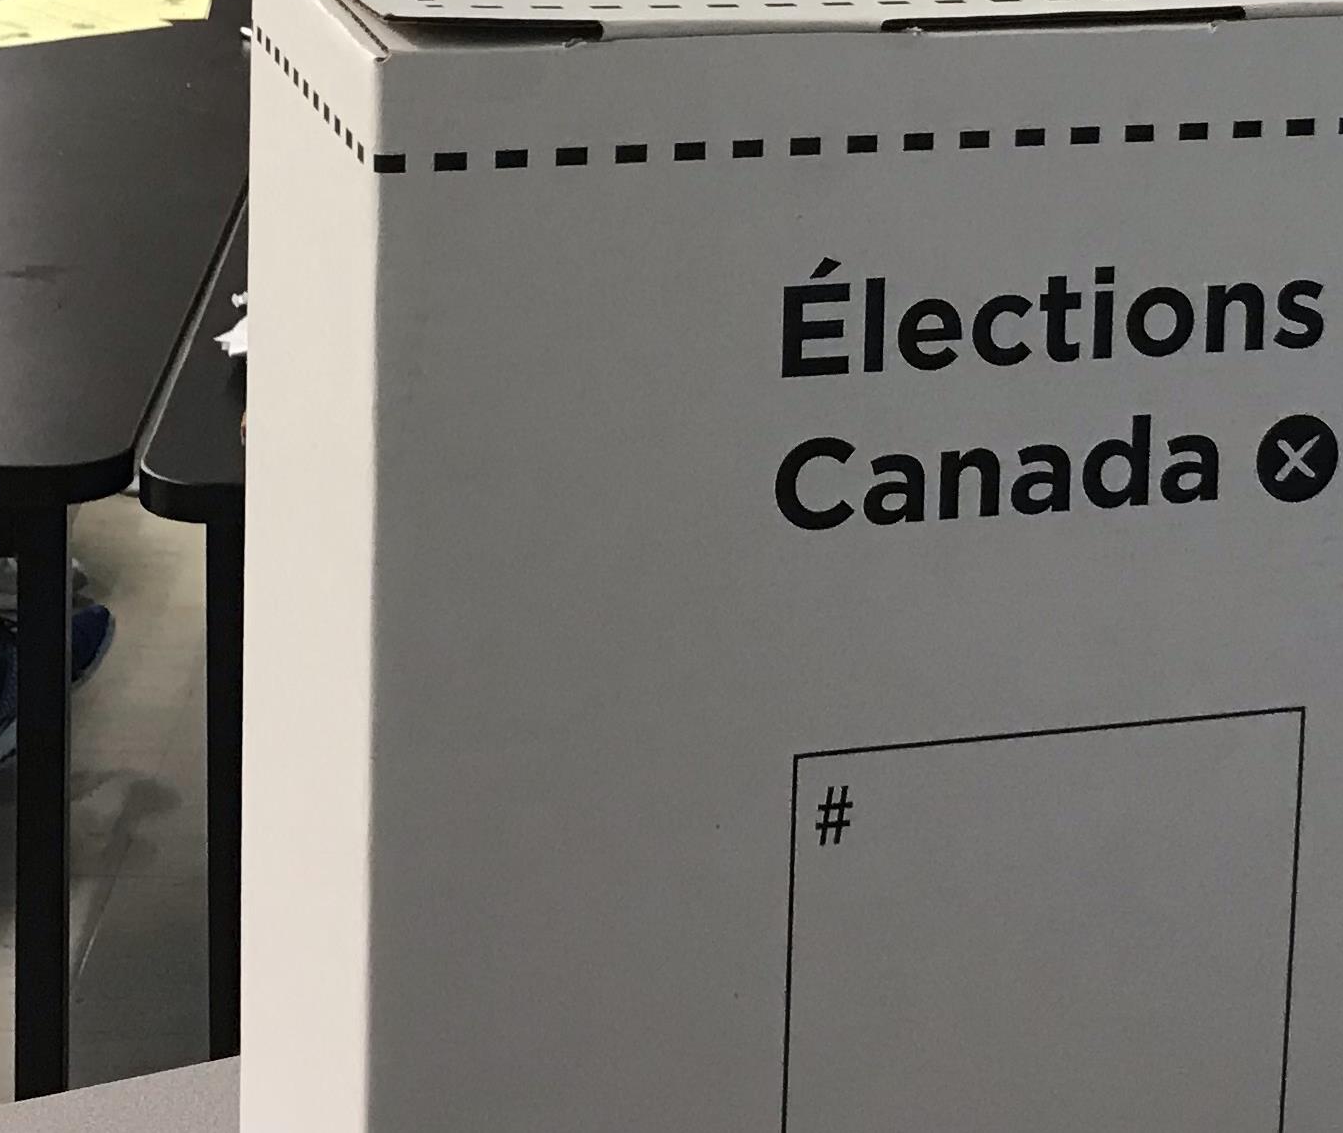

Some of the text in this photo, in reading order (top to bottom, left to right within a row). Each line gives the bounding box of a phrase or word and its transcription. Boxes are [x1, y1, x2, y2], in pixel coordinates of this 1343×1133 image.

[781, 256, 1325, 379] Élections
[774, 413, 1220, 531] Canada
[815, 785, 854, 847] #
